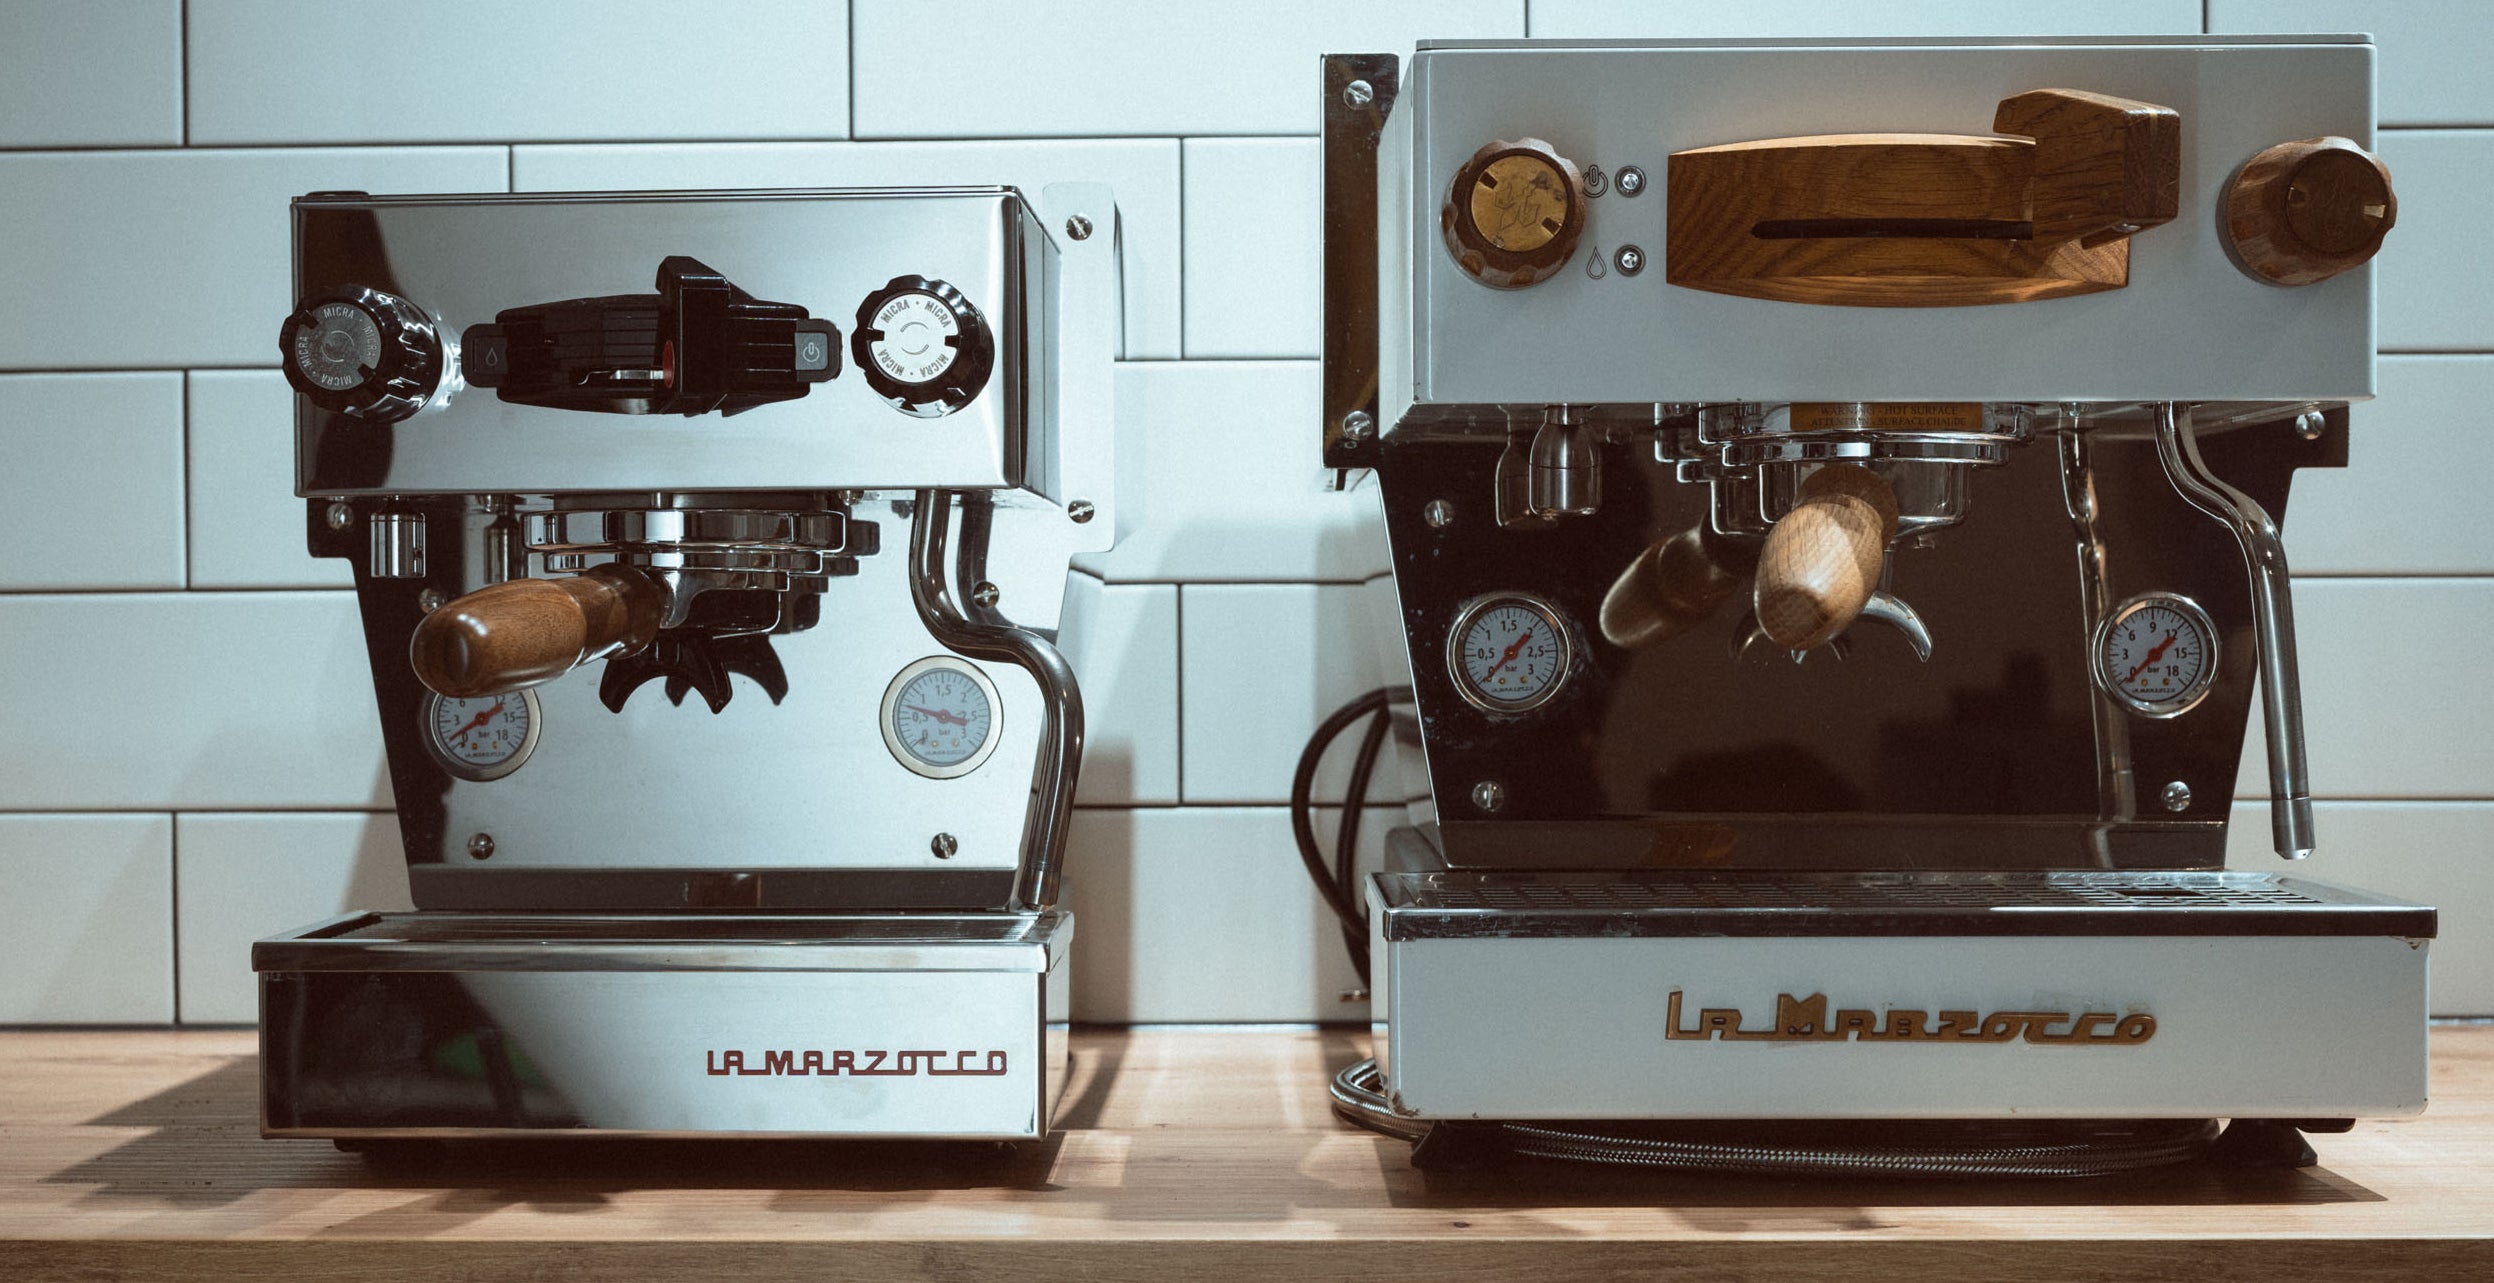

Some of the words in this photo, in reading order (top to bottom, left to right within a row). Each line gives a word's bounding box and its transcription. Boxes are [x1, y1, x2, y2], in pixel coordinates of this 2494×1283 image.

[323, 306, 355, 319] MICRA
[880, 299, 910, 324] MICRA
[924, 300, 952, 328] MICRA
[298, 336, 312, 368] MICRA
[878, 348, 905, 377] MICRA
[919, 353, 949, 378] MICRA
[321, 373, 352, 386] MICRA
[1885, 406, 1907, 415] HOT
[1911, 406, 1958, 415] SURFACE
[1878, 417, 1925, 426] SURFACE
[1927, 417, 1966, 426] CHAUDE
[1501, 620, 1517, 634] 1,5
[1527, 627, 1534, 638] 2
[2149, 621, 2157, 633] 9
[1486, 629, 1491, 640] 1
[2128, 630, 2136, 641] 6
[2165, 629, 2178, 640] 12
[1477, 647, 1495, 661] 0,5
[1527, 645, 1544, 659] 2,5
[2122, 648, 2129, 660] 3
[2174, 647, 2188, 659] 15
[1505, 664, 1517, 672] bar
[1528, 663, 1534, 675] 3
[2166, 665, 2179, 677] 18
[935, 684, 952, 697] 1,5
[921, 693, 926, 705] 1
[961, 692, 967, 703] 2
[453, 714, 460, 726] 3
[504, 711, 516, 723] 15
[912, 711, 929, 725] 0,5
[496, 729, 508, 741] 18
[939, 728, 950, 736] bar
[960, 728, 967, 740] 3
[707, 1050, 744, 1076] LA
[765, 1050, 1008, 1076] MARZOCCO
